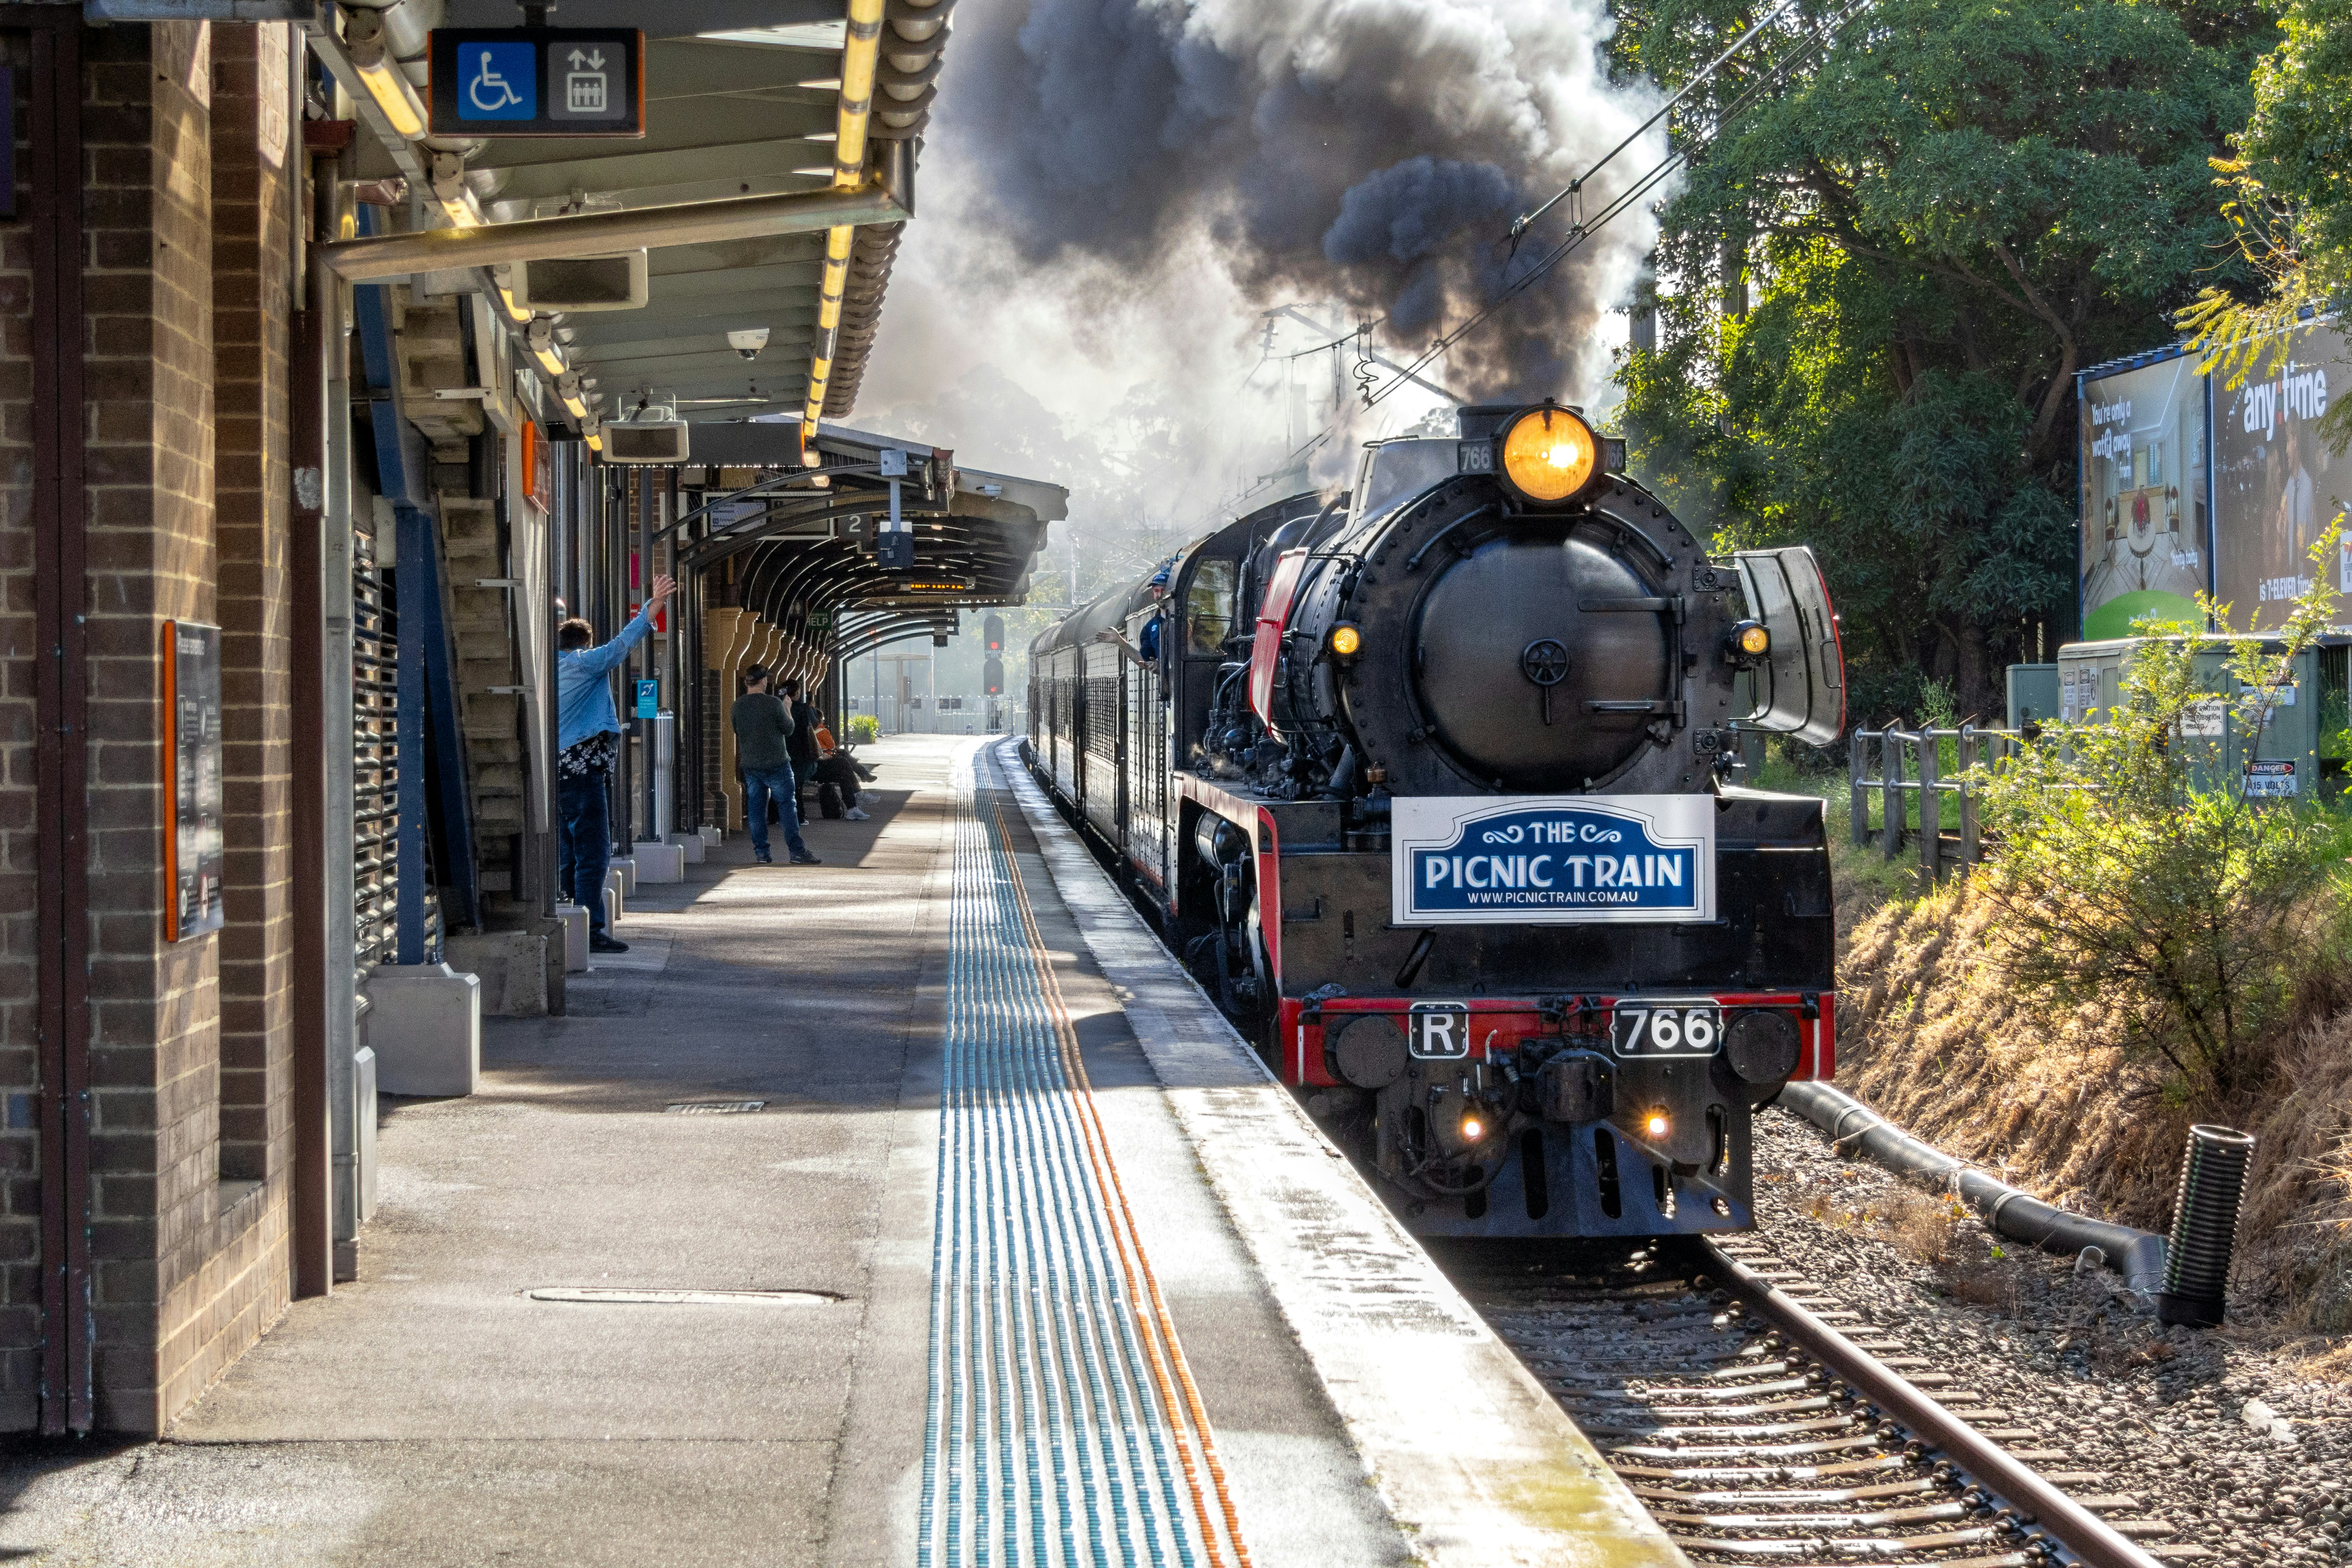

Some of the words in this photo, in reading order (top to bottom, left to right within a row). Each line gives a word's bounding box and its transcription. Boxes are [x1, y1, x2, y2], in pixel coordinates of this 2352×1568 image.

[2091, 401, 2110, 426] You're
[2111, 395, 2125, 426] only
[2126, 401, 2131, 418] a
[2243, 382, 2276, 441] any
[2282, 361, 2326, 422] time
[1460, 446, 1490, 470] 766
[2113, 433, 2131, 457] away
[2119, 461, 2131, 479] from
[849, 515, 861, 532] 2
[2259, 578, 2266, 602] is
[2298, 573, 2314, 598] time
[1525, 821, 1577, 843] THE
[1425, 854, 1553, 888] PICNIC
[1563, 854, 1682, 888] TRAIN
[1467, 891, 1638, 904] WWW.PICNICTRAIN.COM.AU
[1423, 1013, 1454, 1051] R
[1620, 1009, 1713, 1049] 766
